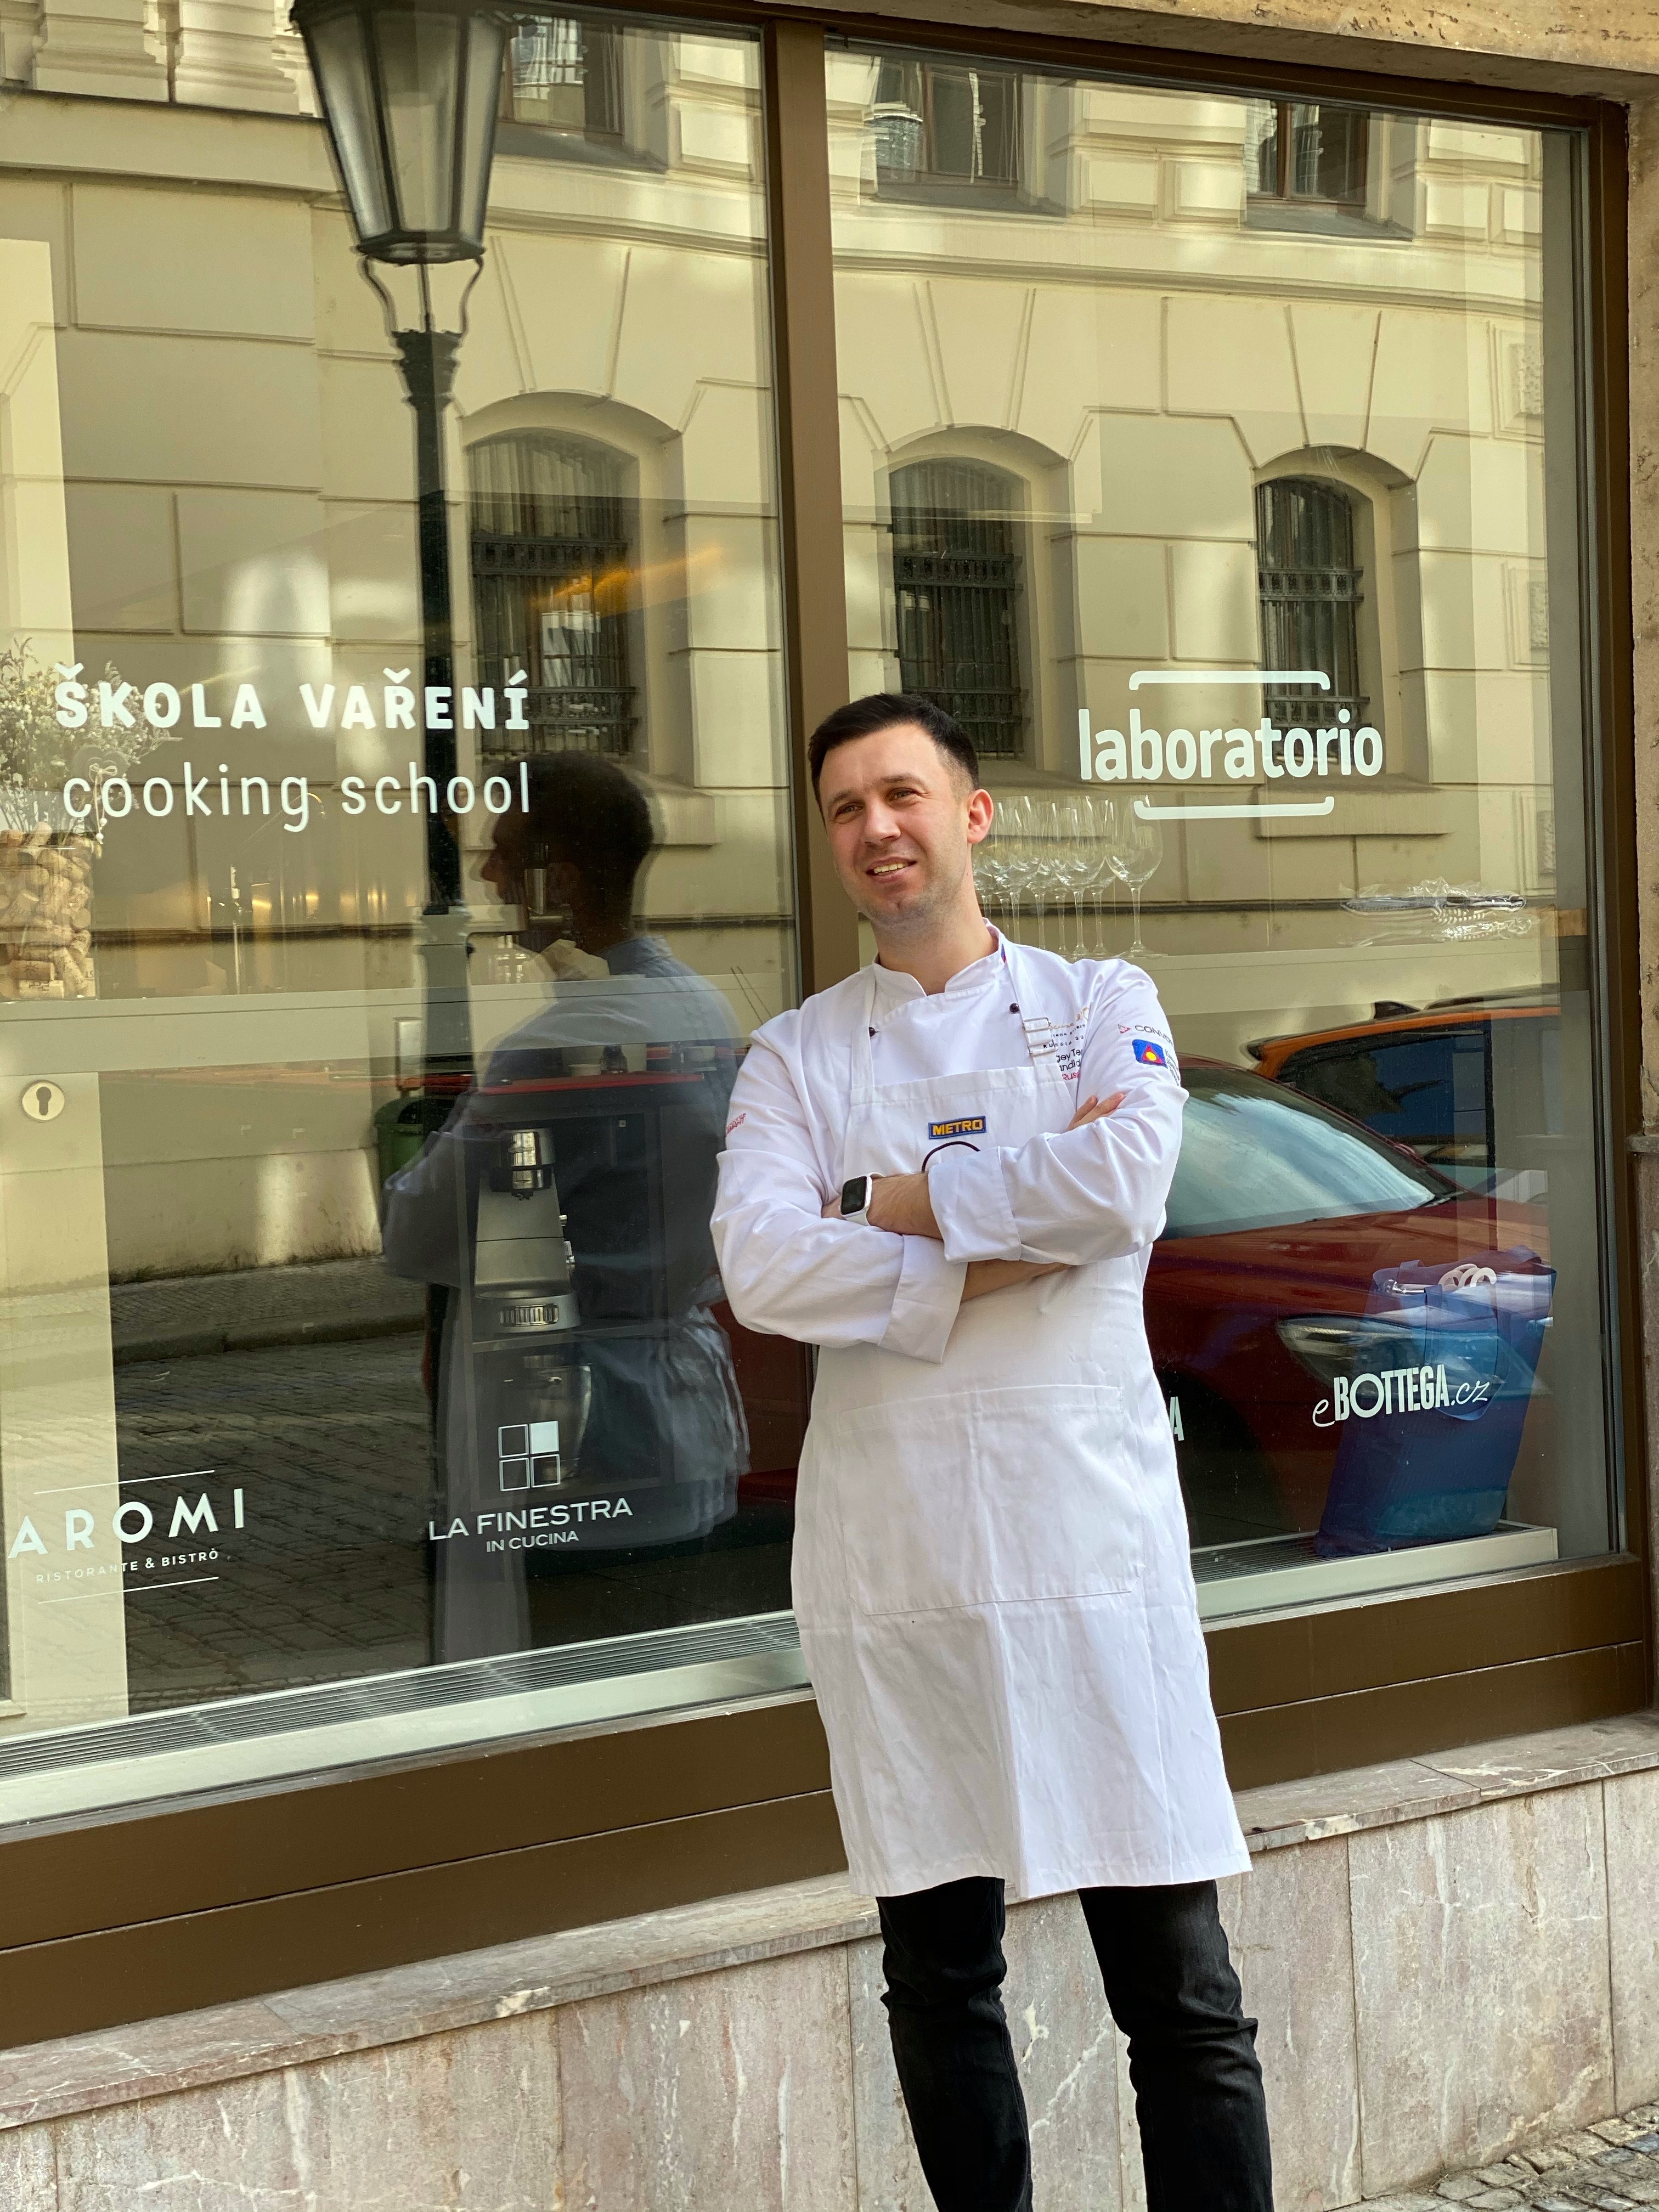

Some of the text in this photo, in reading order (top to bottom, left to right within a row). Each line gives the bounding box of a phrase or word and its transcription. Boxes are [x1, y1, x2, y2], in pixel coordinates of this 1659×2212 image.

[55, 662, 529, 730] ŠKOLA VAŘENÍ
[1079, 708, 1383, 781] laboratorio
[63, 761, 529, 832] cooking school
[932, 1119, 984, 1136] METRO
[8, 1488, 245, 1559] AROMI
[428, 1498, 633, 1541] LA FINESTRA
[486, 1530, 579, 1553] IN CUCINA
[36, 1561, 138, 1584] RISTORANTE
[145, 1557, 155, 1569] &
